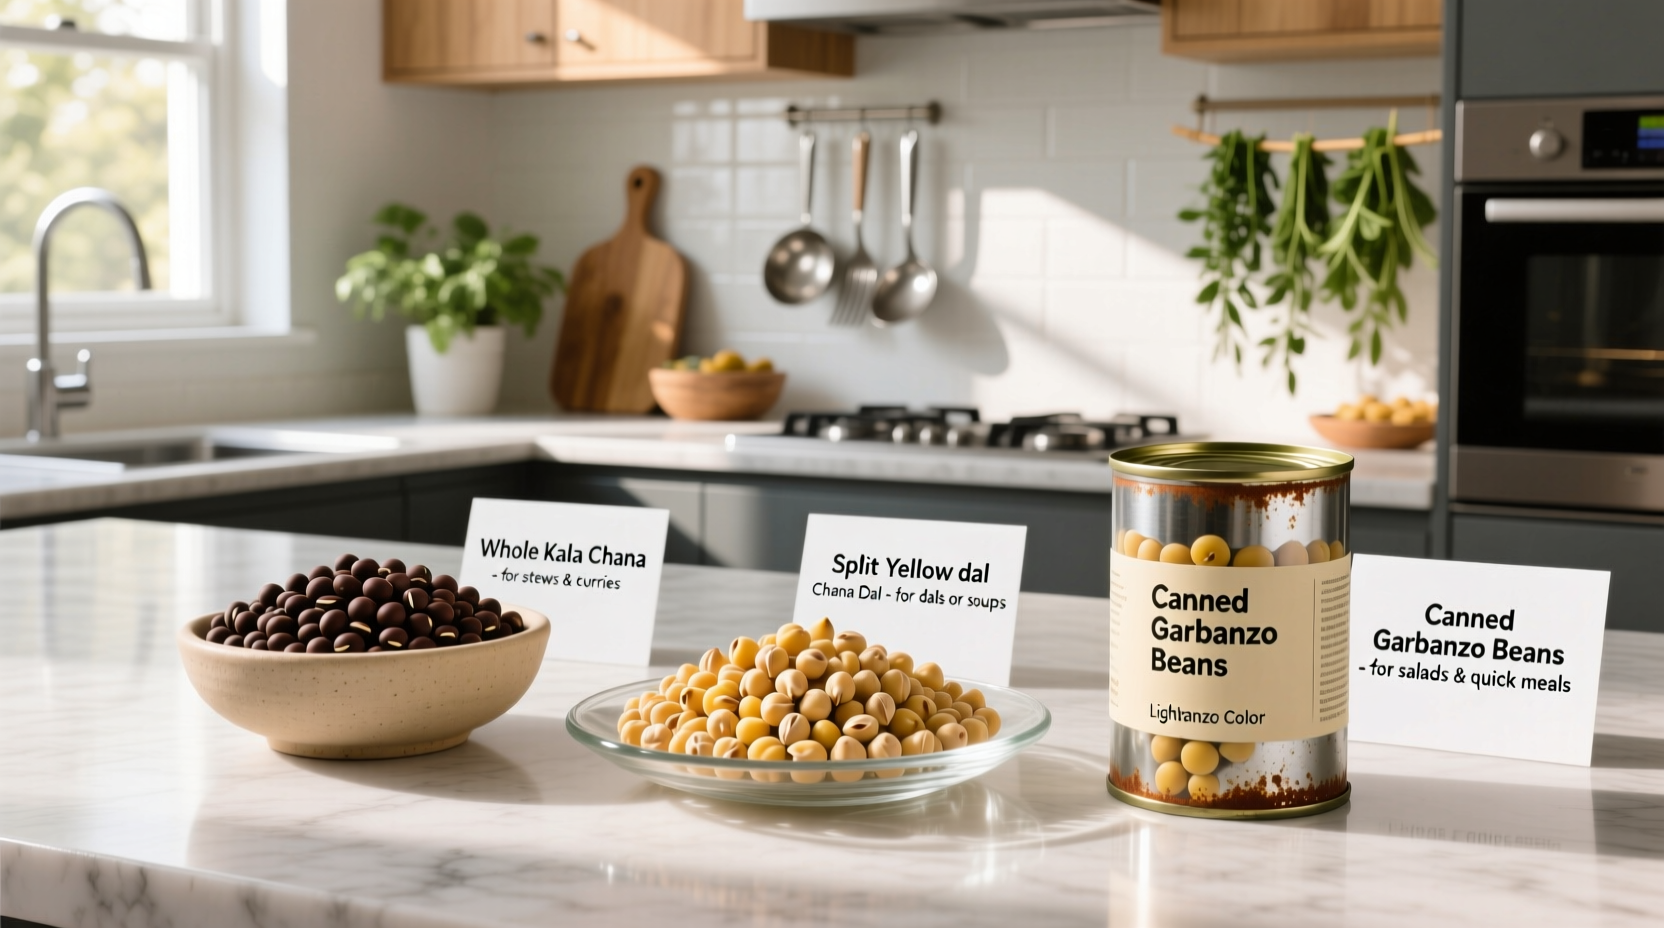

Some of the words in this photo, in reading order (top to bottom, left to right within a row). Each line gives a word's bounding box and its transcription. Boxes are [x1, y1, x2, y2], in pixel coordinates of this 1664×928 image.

[481, 539, 538, 559] Whole
[544, 542, 582, 563] Kala
[589, 545, 645, 568] Chana
[502, 568, 519, 581] for
[522, 572, 559, 585] stews
[563, 574, 571, 586] &
[577, 577, 620, 589] curries
[832, 554, 879, 579] Split
[886, 558, 953, 581] Yellow
[959, 562, 989, 583] dal
[813, 582, 854, 598] Chana
[859, 585, 881, 600] Dal
[896, 587, 915, 602] for
[919, 589, 945, 604] dals
[949, 596, 963, 605] or
[968, 597, 1006, 612] soups
[1152, 584, 1248, 614] Canned
[1152, 616, 1278, 645] Garbanzo
[1425, 603, 1515, 631] Canned
[1374, 629, 1485, 658] Garbanzo
[1493, 638, 1564, 665] Beans
[1152, 647, 1228, 677] Beans
[1370, 658, 1394, 677] for
[1398, 662, 1449, 682] salads
[1454, 668, 1466, 683] &
[1471, 671, 1516, 690] quick
[1522, 675, 1570, 692] meals
[1224, 710, 1265, 724] Color
